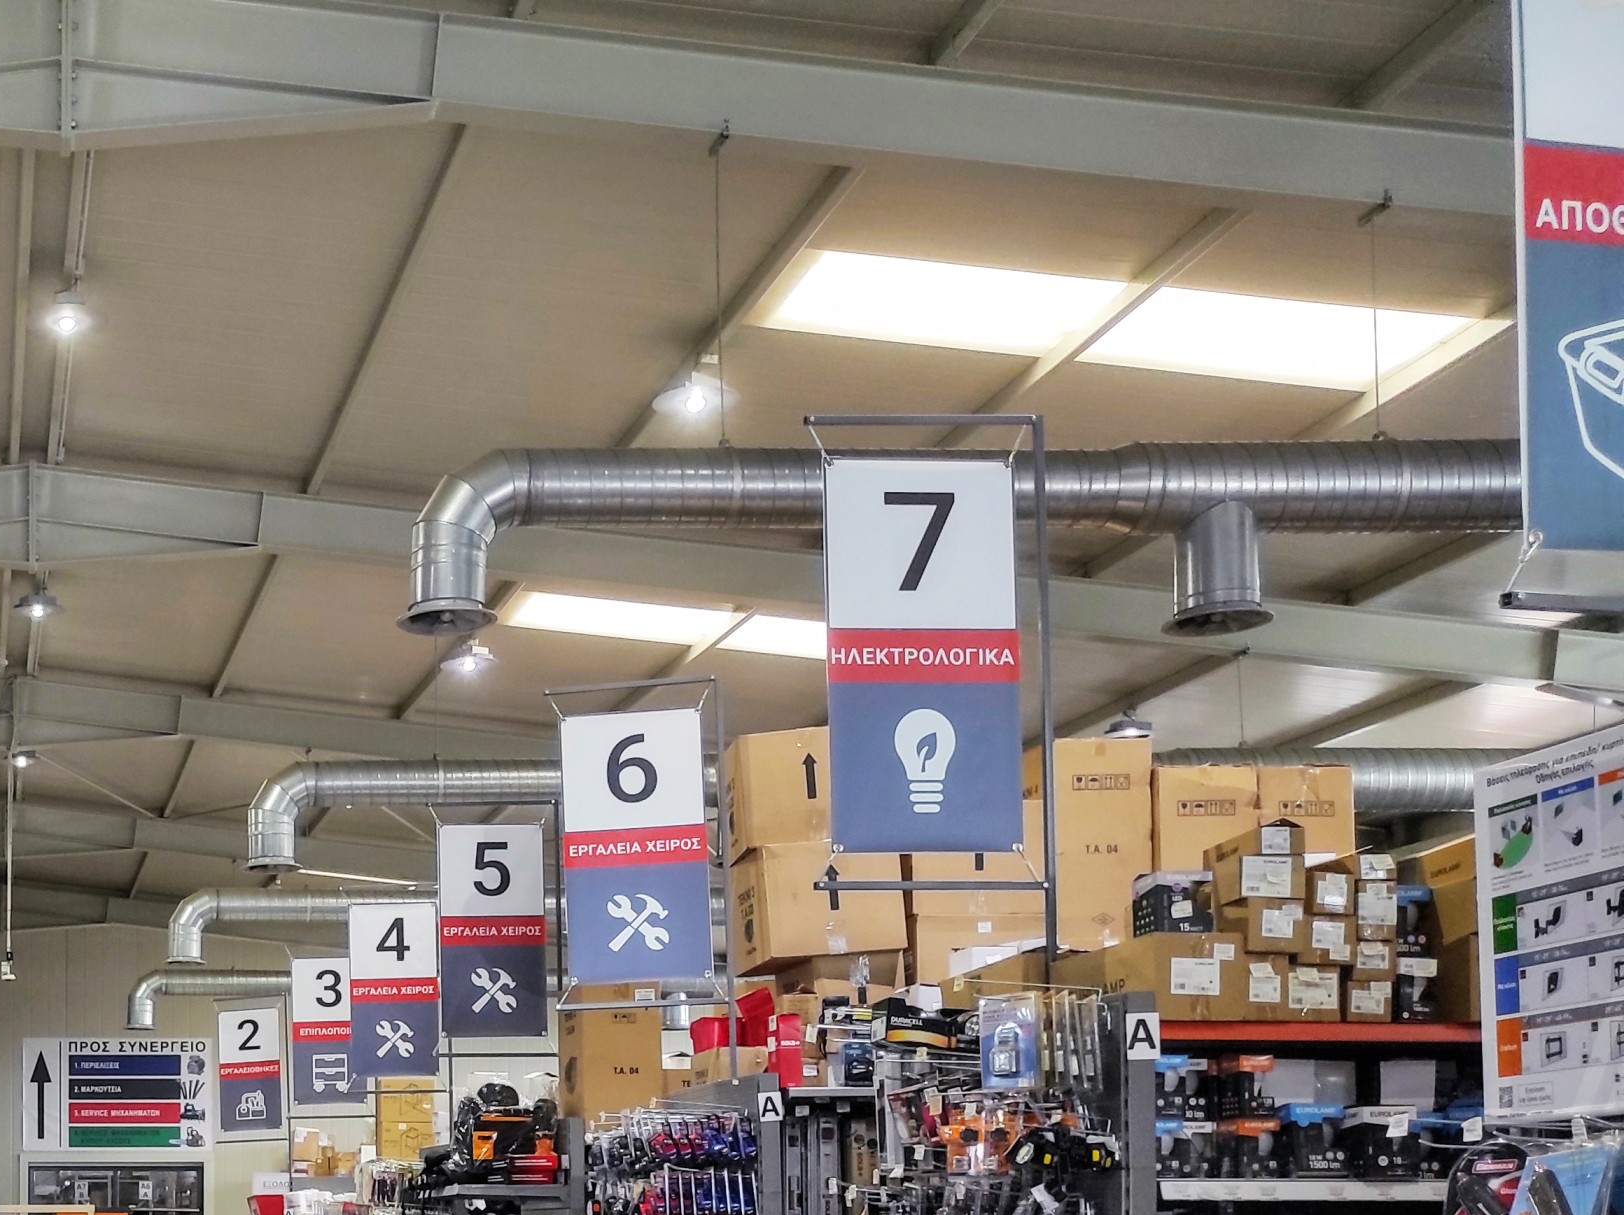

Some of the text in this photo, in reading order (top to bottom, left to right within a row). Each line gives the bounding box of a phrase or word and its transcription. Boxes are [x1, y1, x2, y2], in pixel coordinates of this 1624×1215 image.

[884, 491, 955, 591] 7
[831, 647, 1015, 668] ΗΛΕΚΤΡΟΛΟΓΙΚΑ
[607, 733, 658, 802] 6
[569, 837, 702, 857] ΕΡΓΑΛΕΙΑ ΧΕΙΡΟΣ
[1085, 844, 1118, 854] T.A. 04
[473, 841, 510, 896] 5
[443, 925, 542, 937] ΕΡΓΑΛΕΙΑ ΧΕΙΡΟΣ
[1179, 922, 1190, 931] 15
[376, 917, 411, 961] 4
[315, 969, 343, 1007] 3
[352, 984, 435, 996] ΕΡΓΑΛΕΙΑ ΧΕΙΡΟΣ
[237, 1019, 261, 1051] 2
[1129, 1019, 1156, 1050] A
[68, 1041, 206, 1052] ΠΡΟΣ ΣΥΝΕΡΓΕΙΟ
[221, 1063, 280, 1076] ΕΡΓΑΛΕΙΟΘΗΚΕΣ
[761, 1096, 781, 1117] A
[1309, 1160, 1341, 1169] 1500 lm
[76, 1183, 86, 1191] A7
